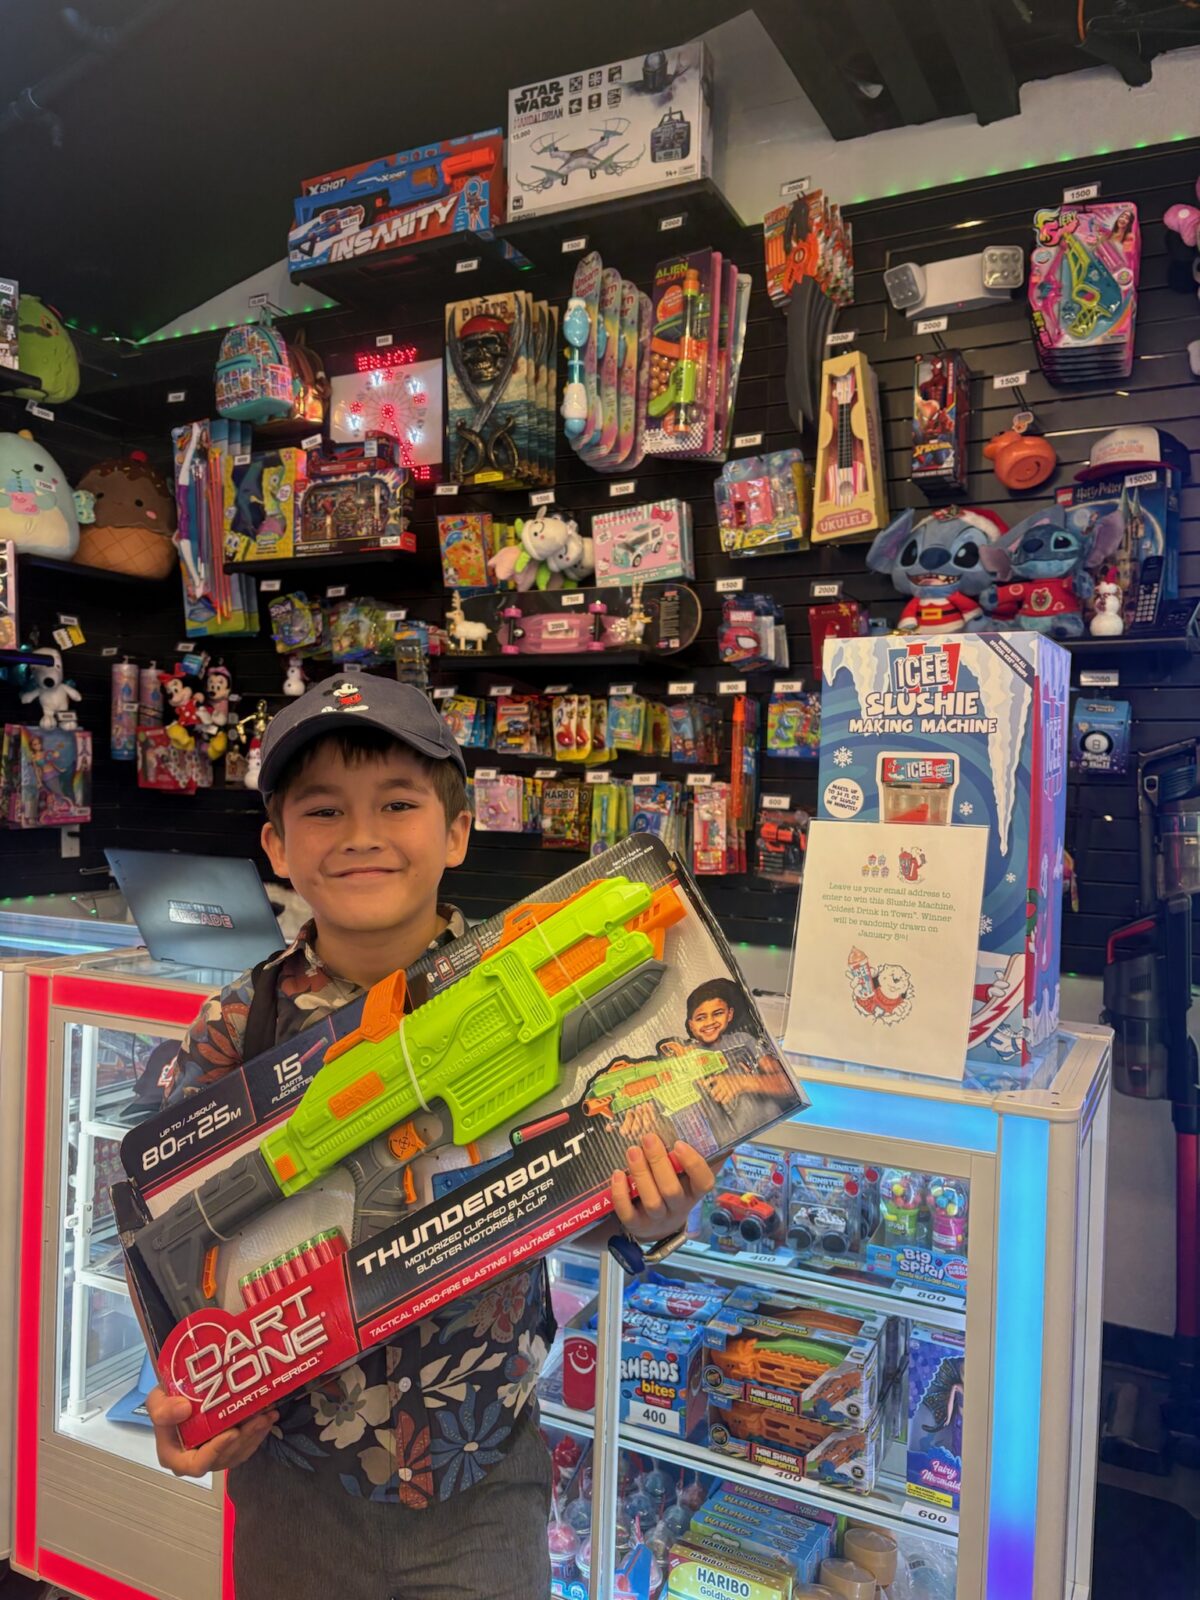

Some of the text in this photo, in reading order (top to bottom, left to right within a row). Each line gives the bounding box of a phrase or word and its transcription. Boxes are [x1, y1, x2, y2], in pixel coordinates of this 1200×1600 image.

[515, 81, 564, 102] STAR
[515, 93, 564, 115] WARS
[1071, 189, 1090, 199] 1500
[330, 195, 458, 263] INSANITY
[656, 262, 688, 278] ALIEN
[462, 300, 508, 320] PIRATE
[923, 321, 942, 330] 2000
[1000, 376, 1020, 385] 1500
[1129, 474, 1153, 484] 15000
[820, 513, 869, 532] UKULELE
[818, 586, 835, 594] 2000
[895, 652, 951, 691] ICEE
[866, 690, 980, 717] SLUSHIE
[849, 718, 997, 734] MAKING MACHINE
[906, 761, 933, 779] ICEE
[829, 882, 852, 891] Leave
[863, 885, 883, 894] your
[884, 886, 907, 895] email
[907, 887, 940, 898] address
[942, 890, 951, 899] to
[822, 893, 841, 901] enter
[843, 894, 852, 902] to
[853, 895, 868, 904] win
[869, 896, 885, 905] this
[886, 898, 917, 908] Slushie
[169, 908, 234, 929] ARCADE
[856, 906, 879, 916] Drink
[880, 908, 889, 917] in
[921, 912, 952, 922] Winner
[833, 916, 847, 924] will
[848, 917, 858, 925] be
[859, 919, 898, 930] randomly
[899, 922, 926, 932] drawn
[858, 929, 893, 941] January
[273, 1053, 302, 1084] 15
[280, 1076, 303, 1092] DARTS
[159, 1129, 171, 1138] UP
[171, 1121, 182, 1133] TO
[357, 1132, 586, 1275] THUNDERBOLT
[404, 1178, 554, 1269] MOTORIZED CLIP-FED BLASTER
[416, 1195, 548, 1275] BLASTER MOTORISÉ À CLIP
[751, 1255, 776, 1263] 400
[903, 1248, 932, 1263] Big
[369, 1310, 412, 1337] TACTICAL
[412, 1282, 461, 1313] RAPID-FIRE
[462, 1256, 507, 1284] BLASTING
[512, 1229, 556, 1258] SAUTAGE
[556, 1203, 599, 1232] TACTIQUE
[599, 1197, 611, 1210] À
[917, 1291, 946, 1302] 800
[185, 1285, 313, 1385] DART
[193, 1315, 329, 1414] ZONE
[620, 1357, 679, 1382] RHEADS
[227, 1387, 271, 1416] DARTS.
[272, 1357, 320, 1388] PERIOD.
[641, 1381, 676, 1399] bites
[749, 1395, 795, 1413] TRANSPORTER
[750, 1388, 792, 1405] MINI SHARK
[643, 1410, 666, 1424] 400
[755, 1454, 800, 1473] TRANSPORTER
[756, 1447, 798, 1465] MINI SHARK
[774, 1471, 802, 1482] 400
[932, 1460, 957, 1480] Fairy
[918, 1509, 947, 1524] 600
[702, 1538, 734, 1554] HARIBO
[690, 1551, 763, 1581] HARIBO Goldbears
[697, 1567, 750, 1597] HARIBO
